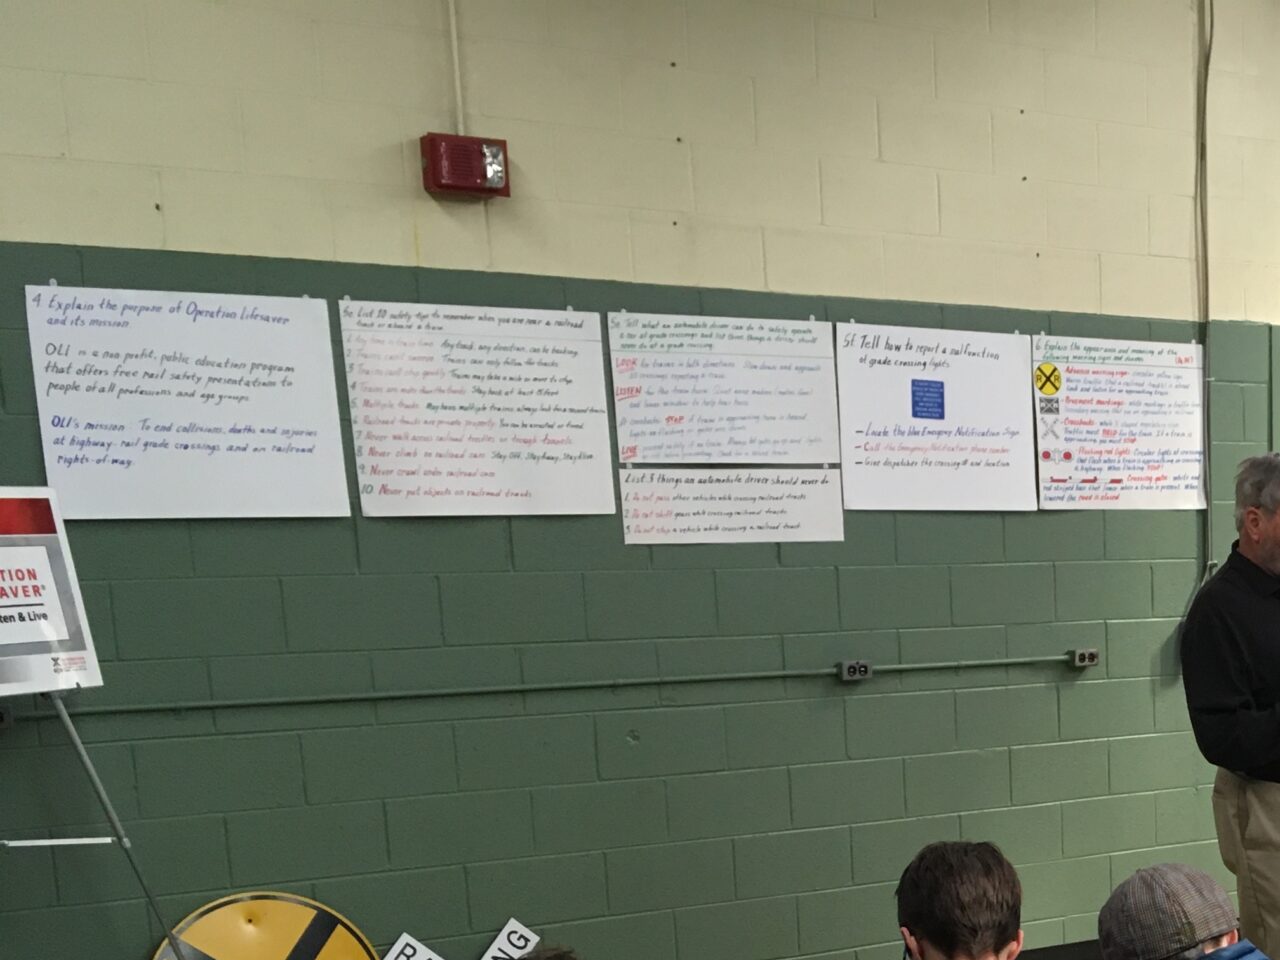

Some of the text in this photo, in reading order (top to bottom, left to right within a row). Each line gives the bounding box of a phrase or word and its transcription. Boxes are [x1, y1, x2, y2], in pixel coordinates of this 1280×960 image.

[48, 294, 94, 315] Explain
[99, 298, 117, 310] the
[120, 303, 163, 316] purpose
[168, 300, 183, 314] of
[186, 301, 237, 323] Operation
[240, 306, 290, 325] Lifesaver
[46, 316, 66, 326] and
[70, 316, 86, 326] its
[357, 306, 374, 318] List
[390, 310, 412, 322] safety
[432, 308, 440, 318] to
[443, 312, 475, 320] remember
[478, 312, 495, 322] when
[498, 317, 510, 327] you
[525, 318, 542, 326] near
[554, 318, 584, 329] railroad
[860, 334, 881, 350] Tell
[884, 336, 902, 351] how
[904, 338, 913, 351] to
[916, 343, 939, 356] report
[950, 344, 1000, 361] malfunction
[1044, 341, 1178, 356] Explain the appearance and meaning of the
[45, 343, 70, 357] OLI
[92, 350, 99, 358] a
[160, 350, 190, 366] public
[195, 356, 246, 370] education
[250, 362, 295, 377] program
[859, 356, 951, 371] of grade crossing lights
[44, 360, 293, 389] that offers free rail safety presentations to
[1036, 374, 1060, 382] R R
[46, 380, 80, 398] people
[86, 382, 96, 393] of
[98, 382, 116, 393] all
[117, 386, 171, 399] professions
[176, 390, 196, 398] and
[200, 392, 215, 404] age
[616, 385, 642, 397] LISTEN
[52, 415, 80, 429] OLI's
[138, 418, 151, 431] To
[154, 422, 172, 432] end
[228, 423, 256, 434] deaths
[260, 426, 277, 434] and
[281, 428, 318, 439] injuries
[865, 422, 1020, 440] Locate the blue Emergency Notification Sign
[53, 436, 66, 446] at
[143, 438, 170, 451] grade
[174, 443, 221, 456] crossings
[226, 443, 248, 452] and
[272, 442, 316, 454] railroad
[863, 441, 881, 452] Call
[864, 456, 1010, 470] Give dispatcher the crossing and location
[624, 473, 646, 484] List
[657, 473, 683, 489] things
[684, 476, 695, 484] an
[698, 474, 743, 484] automobile
[744, 474, 770, 484] driver
[771, 475, 799, 486] should
[801, 478, 819, 486] never
[820, 474, 830, 485] do
[378, 484, 402, 496] Never
[405, 486, 420, 499] put
[466, 488, 502, 498] railroad
[672, 493, 691, 502] other
[692, 493, 717, 502] vehicles
[734, 495, 756, 504] crossing
[758, 494, 784, 502] railroad
[707, 510, 734, 519] crossing
[734, 509, 761, 517] railroad
[721, 525, 746, 534] crossing
[756, 523, 780, 531] railroad
[18, 612, 26, 622] &
[27, 610, 48, 622] Live
